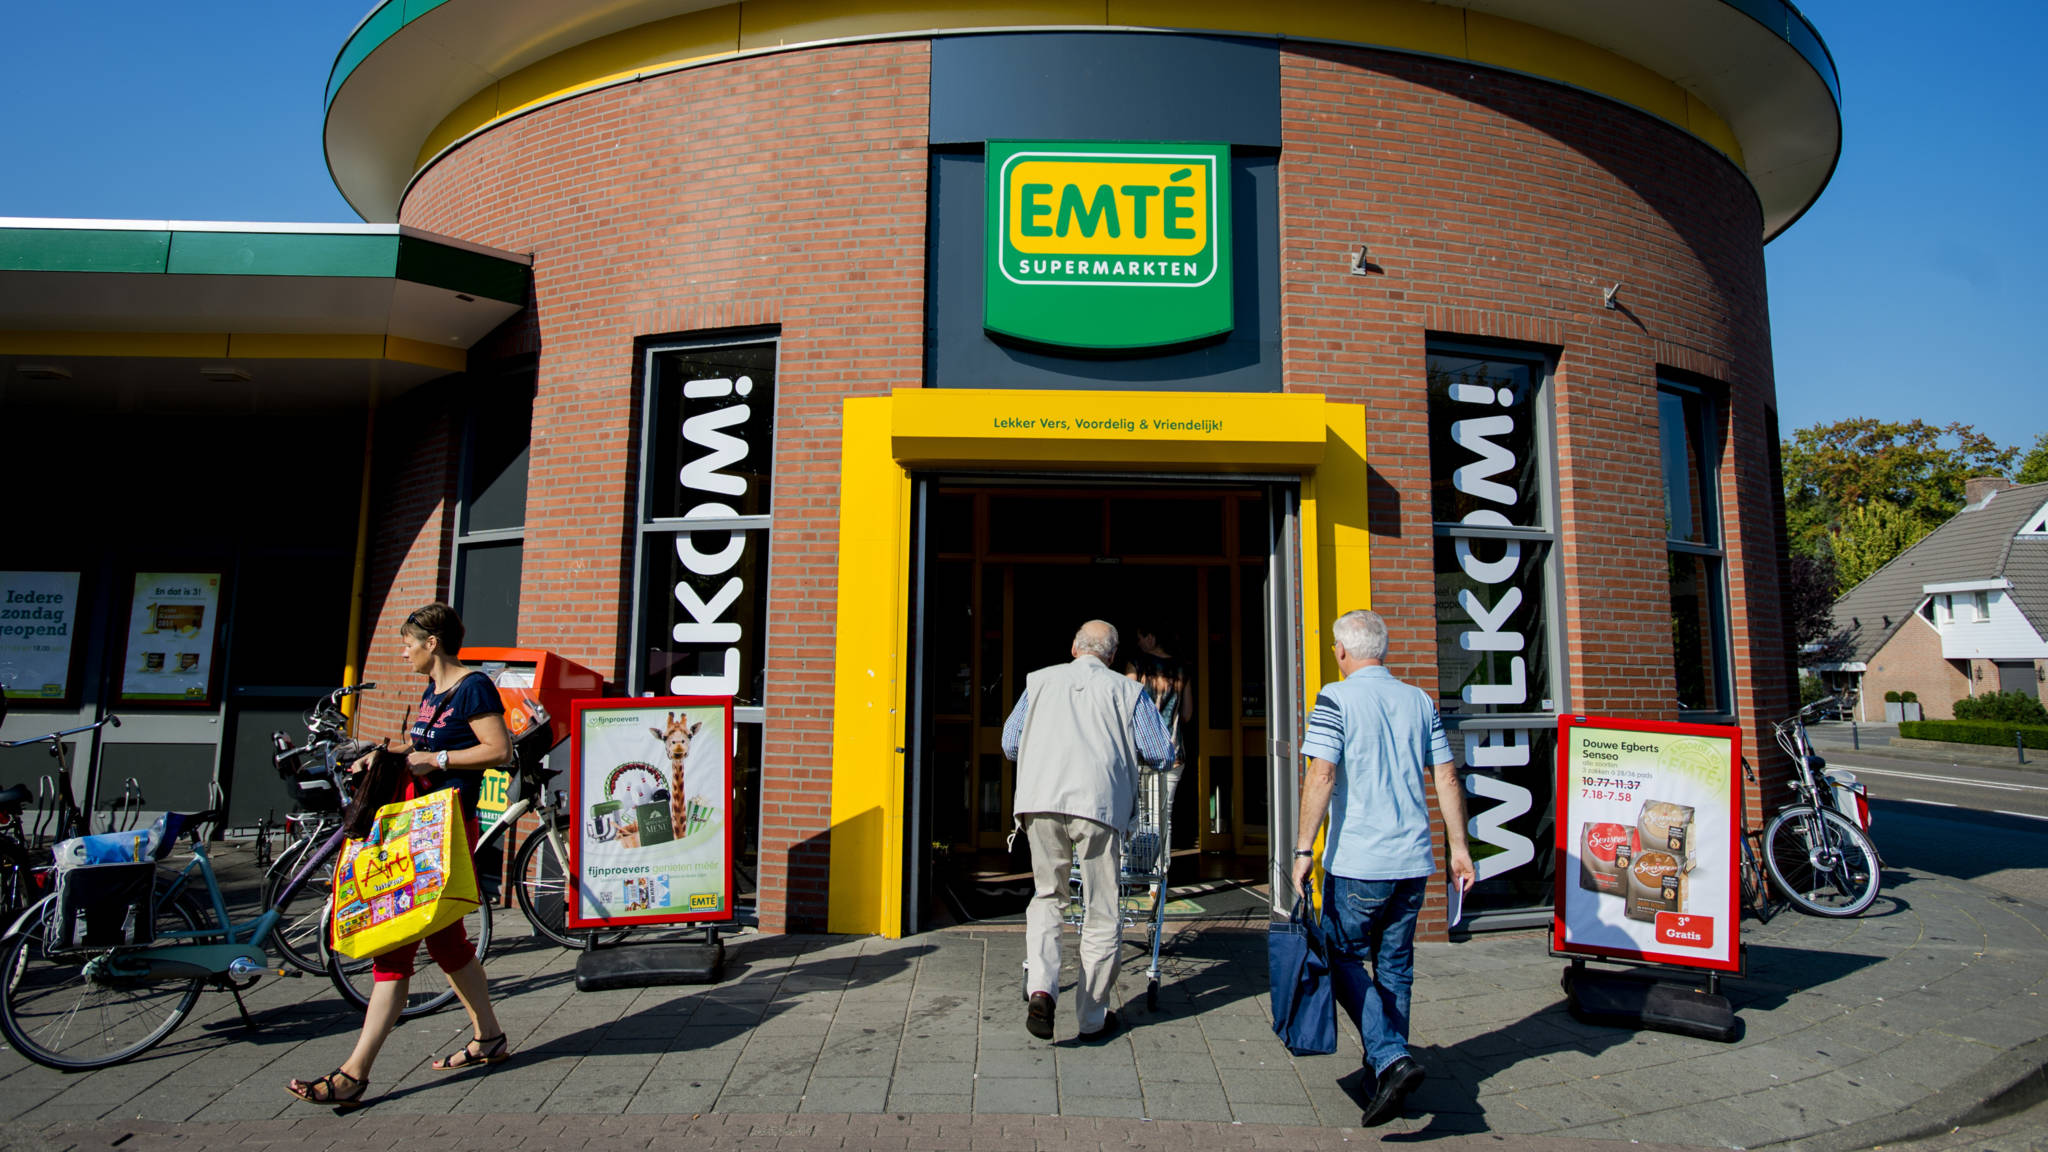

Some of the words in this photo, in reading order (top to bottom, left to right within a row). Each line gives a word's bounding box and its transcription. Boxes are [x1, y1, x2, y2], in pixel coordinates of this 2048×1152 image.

[1020, 167, 1196, 240] EMTÉ
[1019, 259, 1197, 277] SUPERMARKTEN
[993, 417, 1036, 429] Lekker
[1040, 418, 1071, 431] Vers,
[1075, 418, 1135, 432] Voordelig
[1139, 419, 1149, 430] &
[1153, 419, 1223, 434] Vriendelijk!
[670, 375, 754, 696] LKOM!
[6, 590, 63, 604] Iedere
[155, 587, 166, 596] En
[167, 587, 182, 596] dat
[184, 587, 191, 596] is
[1, 606, 64, 623] zondag
[1448, 382, 1535, 881] WELKOM!
[598, 715, 640, 724] fijnproevers
[1582, 738, 1618, 750] Douwe
[1621, 741, 1659, 753] Egberts
[1582, 750, 1619, 761] Senseo
[588, 865, 650, 878] fijnproevers
[691, 895, 716, 906] EMTÉ
[1666, 928, 1702, 941] Gratis
